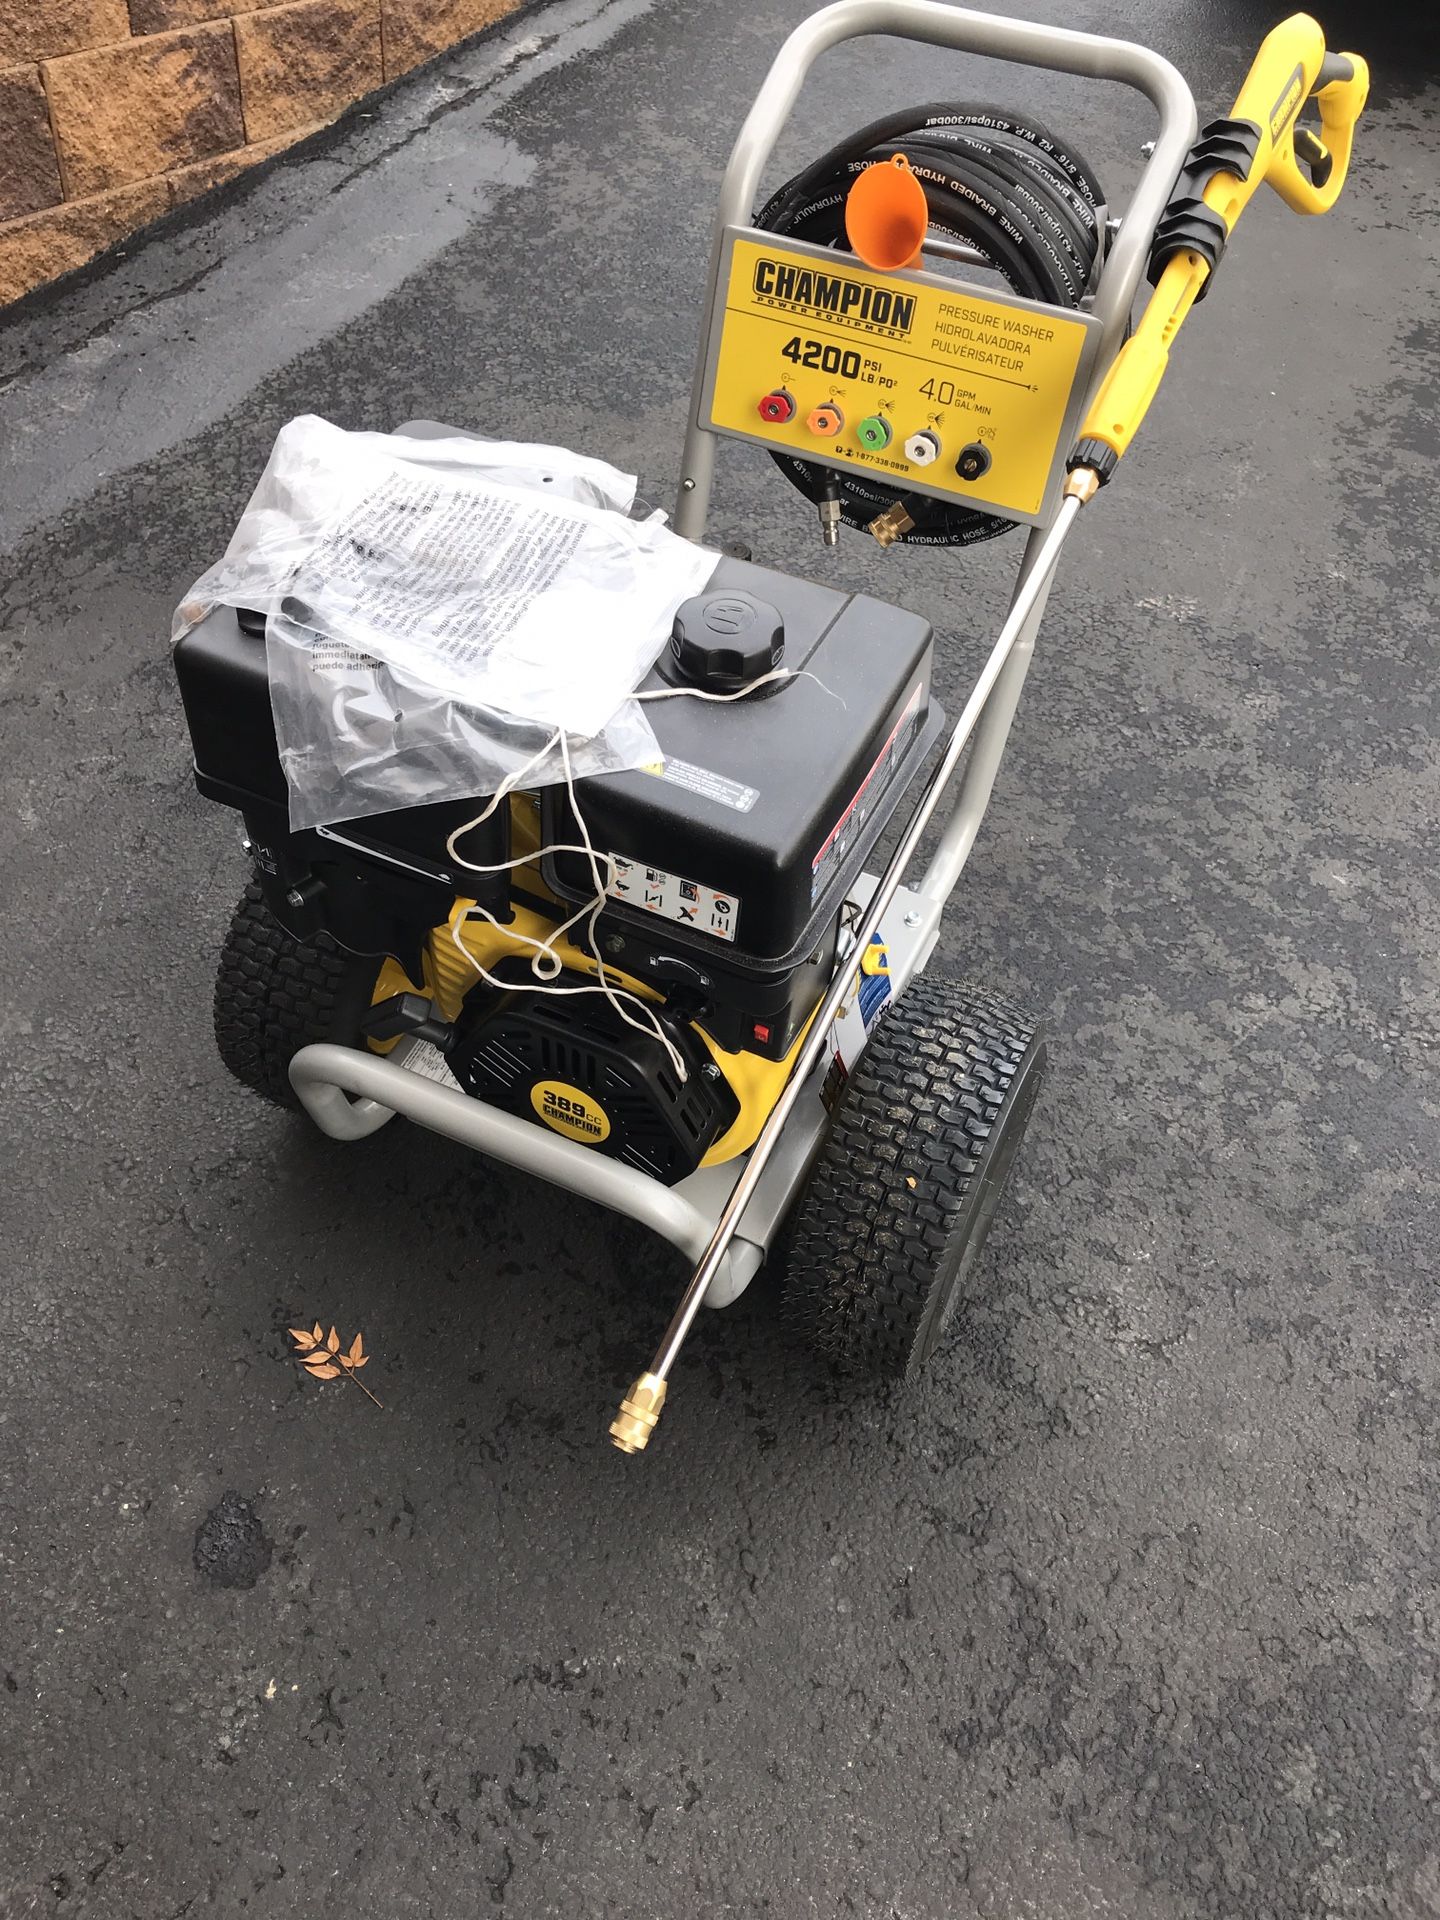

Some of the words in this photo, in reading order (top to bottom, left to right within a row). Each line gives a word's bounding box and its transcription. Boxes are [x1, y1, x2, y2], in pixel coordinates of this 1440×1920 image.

[1015, 125, 1036, 142] W.P.
[1038, 139, 1054, 153] R2
[950, 180, 996, 217] BRAIDED
[1074, 199, 1095, 229] WIRE
[999, 216, 1024, 244] WIRE
[754, 259, 917, 333] CHAMPION
[757, 296, 807, 314] POWER
[815, 311, 905, 339] EQUIPMENT
[938, 303, 1000, 329] PRESSURE
[1003, 319, 1054, 342] WASHER
[931, 338, 1024, 372] PULVÉRISATEUR
[935, 321, 1031, 356] HIDROLAVADORA
[782, 337, 861, 379] 4200
[863, 360, 882, 372] PSI
[919, 378, 955, 405] 4.0
[957, 389, 977, 401] GPM
[954, 399, 991, 416] GAL/MIN
[543, 1104, 602, 1136] CHAMPION
